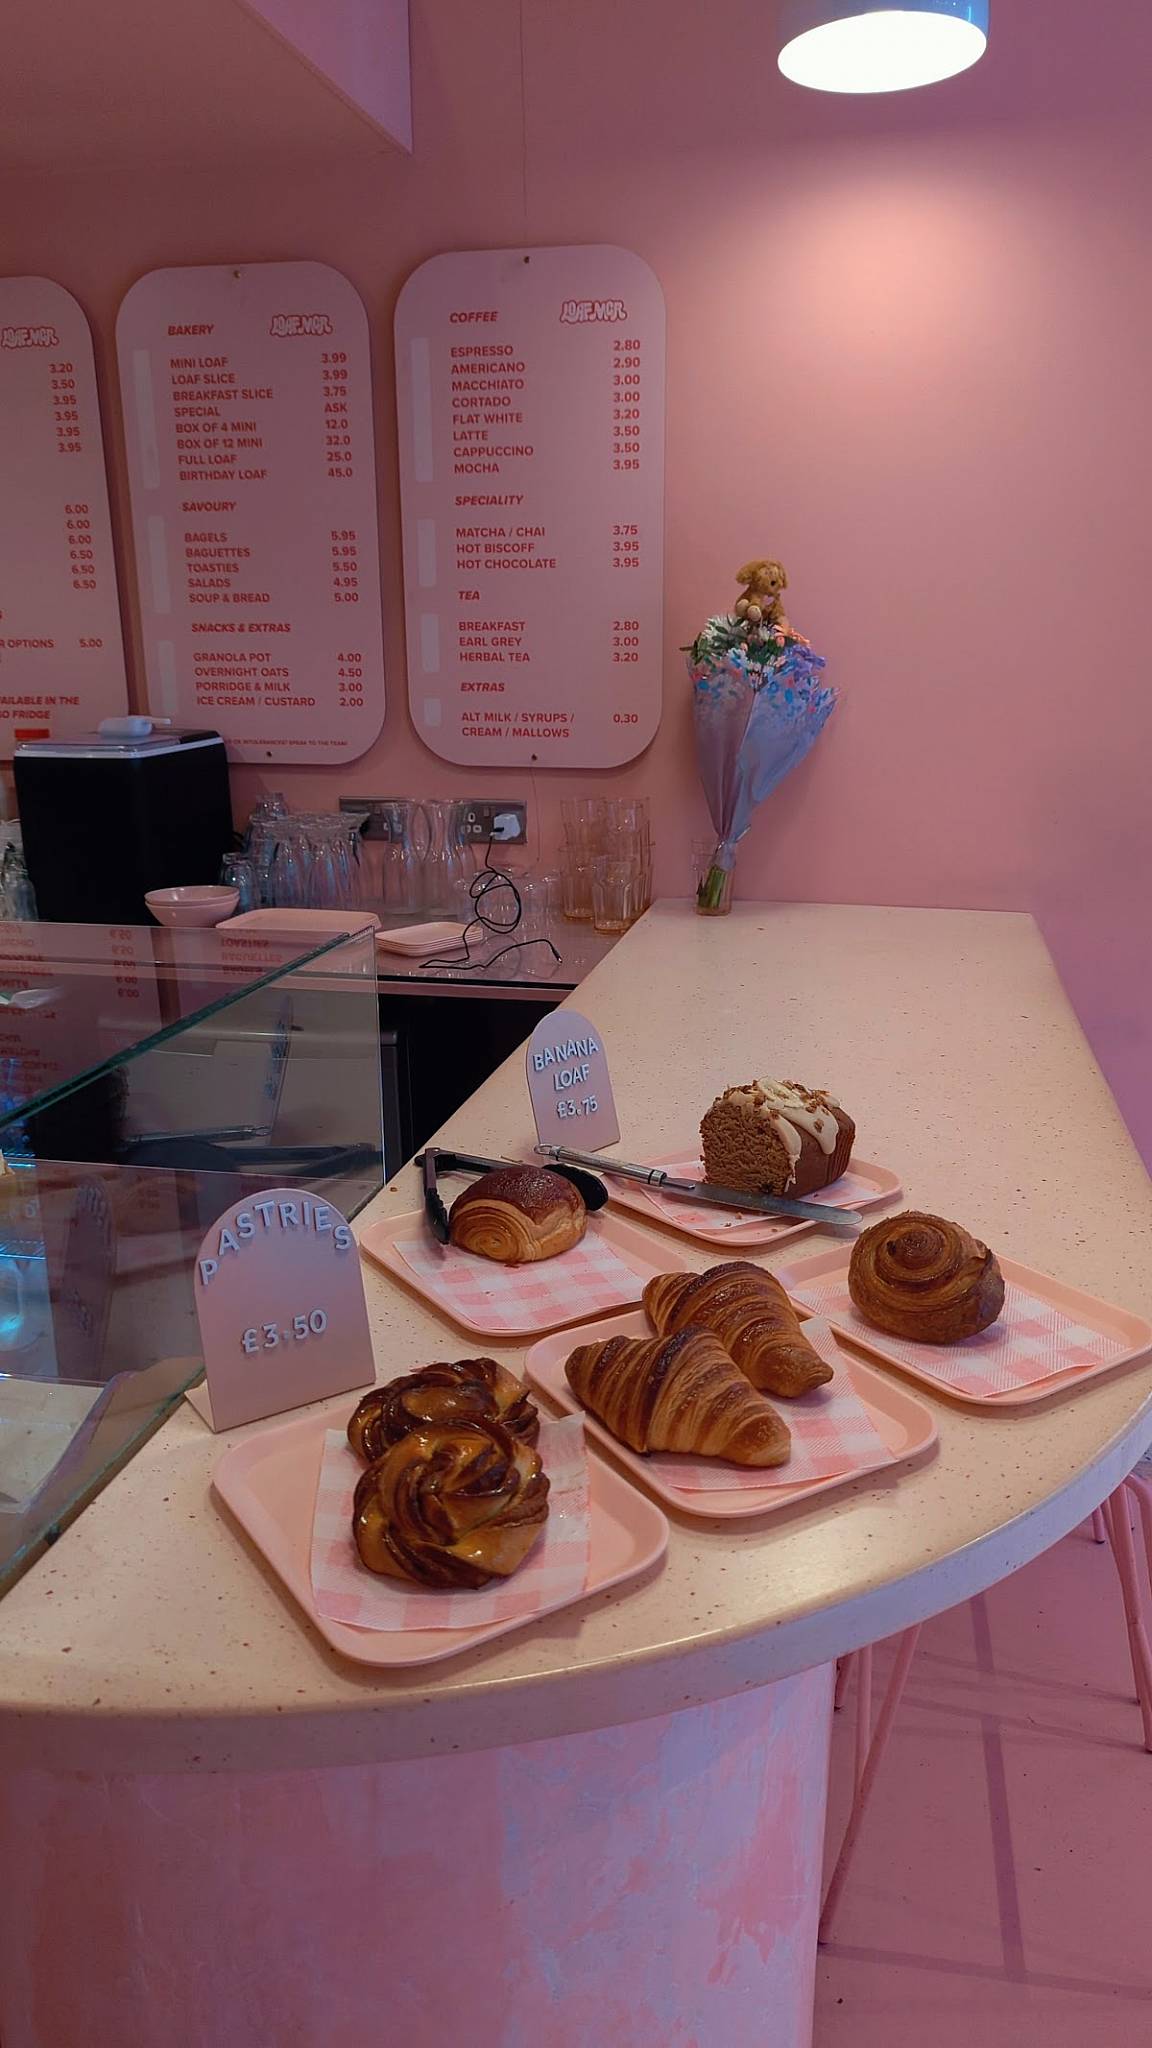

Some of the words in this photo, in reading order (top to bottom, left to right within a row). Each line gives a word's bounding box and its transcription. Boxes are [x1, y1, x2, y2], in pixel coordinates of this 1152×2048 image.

[450, 311, 497, 323] COFFEE
[168, 325, 214, 336] BAKERY
[451, 346, 513, 357] ESPRESSO
[614, 340, 640, 351] 2.80
[170, 358, 195, 368] MINI
[199, 357, 228, 368] LOAF
[322, 352, 347, 363] 3.99
[451, 362, 525, 374] AMERICANO
[614, 357, 640, 368] 2.90
[50, 363, 72, 373] 3.20
[172, 374, 200, 384] LOAF
[203, 373, 235, 384] SLICE
[323, 369, 347, 380] 3.99
[52, 379, 75, 389] 3.50
[452, 379, 524, 391] MACCHIATO
[614, 374, 640, 385] 3.00
[173, 390, 238, 401] BREAKFAST
[242, 389, 272, 399] SLICE
[324, 386, 346, 397] 3.75
[54, 395, 76, 405] 3.95
[452, 396, 511, 408] CORTADO
[614, 392, 640, 402] 3.00
[175, 407, 220, 417] SPECIAL
[325, 402, 347, 413] ASK
[55, 411, 78, 421] 3.95
[453, 414, 480, 424] FLAT
[484, 413, 522, 424] WHITE
[613, 409, 639, 420] 3.20
[57, 427, 80, 436] 3.95
[176, 423, 199, 433] BOX
[202, 422, 218, 432] OF
[221, 423, 228, 432] 4
[231, 422, 256, 432] MINI
[326, 419, 348, 429] 12.0
[453, 431, 488, 441] LATTE
[614, 426, 640, 436] 3.50
[59, 442, 81, 452] 3.95
[177, 439, 200, 449] BOX
[203, 439, 219, 448] OF
[222, 438, 233, 448] 12
[237, 438, 262, 448] MINI
[326, 435, 350, 445] 32.0
[454, 446, 533, 457] CAPPUCCINO
[614, 442, 639, 453] 3.50
[178, 455, 206, 465] FULL
[208, 454, 236, 464] LOAF
[327, 452, 352, 461] 25.0
[455, 463, 499, 473] MOCHA
[613, 459, 639, 470] 3.95
[180, 470, 235, 480] BIRTHDAY
[239, 469, 266, 480] LOAF
[328, 468, 352, 477] 45.0
[456, 495, 523, 506] SPECIALITY
[65, 504, 88, 514] 6.00
[183, 502, 236, 512] SAVOURY
[67, 520, 90, 529] 6.00
[185, 533, 227, 542] BAGELS
[331, 531, 355, 540] 5.95
[456, 528, 505, 538] MATCHA
[516, 527, 544, 536] CHAI
[613, 525, 637, 535] 3.75
[69, 535, 91, 544] 6.00
[186, 548, 250, 558] BAGUETTES
[332, 546, 356, 556] 5.95
[457, 544, 480, 553] HOT
[485, 543, 534, 553] BISCOFF
[614, 541, 639, 551] 3.95
[70, 550, 93, 559] 6.50
[188, 563, 239, 572] TOASTIES
[333, 562, 357, 571] 5.50
[457, 560, 481, 569] HOT
[485, 559, 555, 568] CHOCOLATE
[613, 557, 639, 567] 3.95
[72, 565, 95, 574] 6.50
[73, 580, 96, 589] 6.50
[188, 578, 230, 588] SALADS
[334, 577, 357, 587] 4.95
[189, 593, 220, 603] SOUP
[223, 594, 230, 602] &
[233, 593, 270, 603] BREAD
[334, 593, 358, 602] 5.00
[459, 591, 479, 600] TEA
[192, 623, 235, 632] SNACKS
[238, 624, 245, 632] &
[248, 624, 290, 632] EXTRAS
[459, 622, 525, 631] BREAKFAST
[614, 621, 639, 631] 2.80
[7, 639, 54, 648] OPTIONS
[79, 638, 102, 647] 5.00
[460, 637, 488, 646] EARL
[491, 637, 521, 646] GREY
[613, 637, 639, 646] 3.00
[193, 653, 246, 662] GRANOLA
[249, 653, 270, 662] POT
[338, 653, 361, 662] 4.00
[460, 652, 504, 661] HERBAL
[508, 653, 530, 662] TEA
[613, 652, 638, 662] 3.20
[195, 667, 257, 676] OVERNIGHT
[261, 668, 288, 677] OATS
[338, 668, 362, 677] 4.50
[196, 682, 251, 691] PORRIDGE
[254, 683, 261, 691] &
[264, 683, 290, 691] MILK
[339, 683, 362, 692] 3.00
[461, 683, 504, 692] EXTRAS
[59, 697, 79, 705] THE
[197, 696, 214, 705] ICE
[217, 697, 255, 705] CREAM
[265, 697, 315, 706] CUSTARD
[340, 698, 363, 706] 2.00
[13, 710, 50, 719] FRIDGE
[462, 712, 480, 721] ALT
[484, 713, 511, 722] MILK
[522, 713, 567, 722] SYRUPS
[613, 714, 638, 723] 0.30
[462, 727, 502, 736] CREAM
[512, 728, 569, 737] MALLOWS
[533, 1038, 599, 1071] BANANA
[553, 1064, 591, 1091] LOAF
[557, 1095, 598, 1118] £3.75
[199, 1200, 351, 1286] PASTRIES
